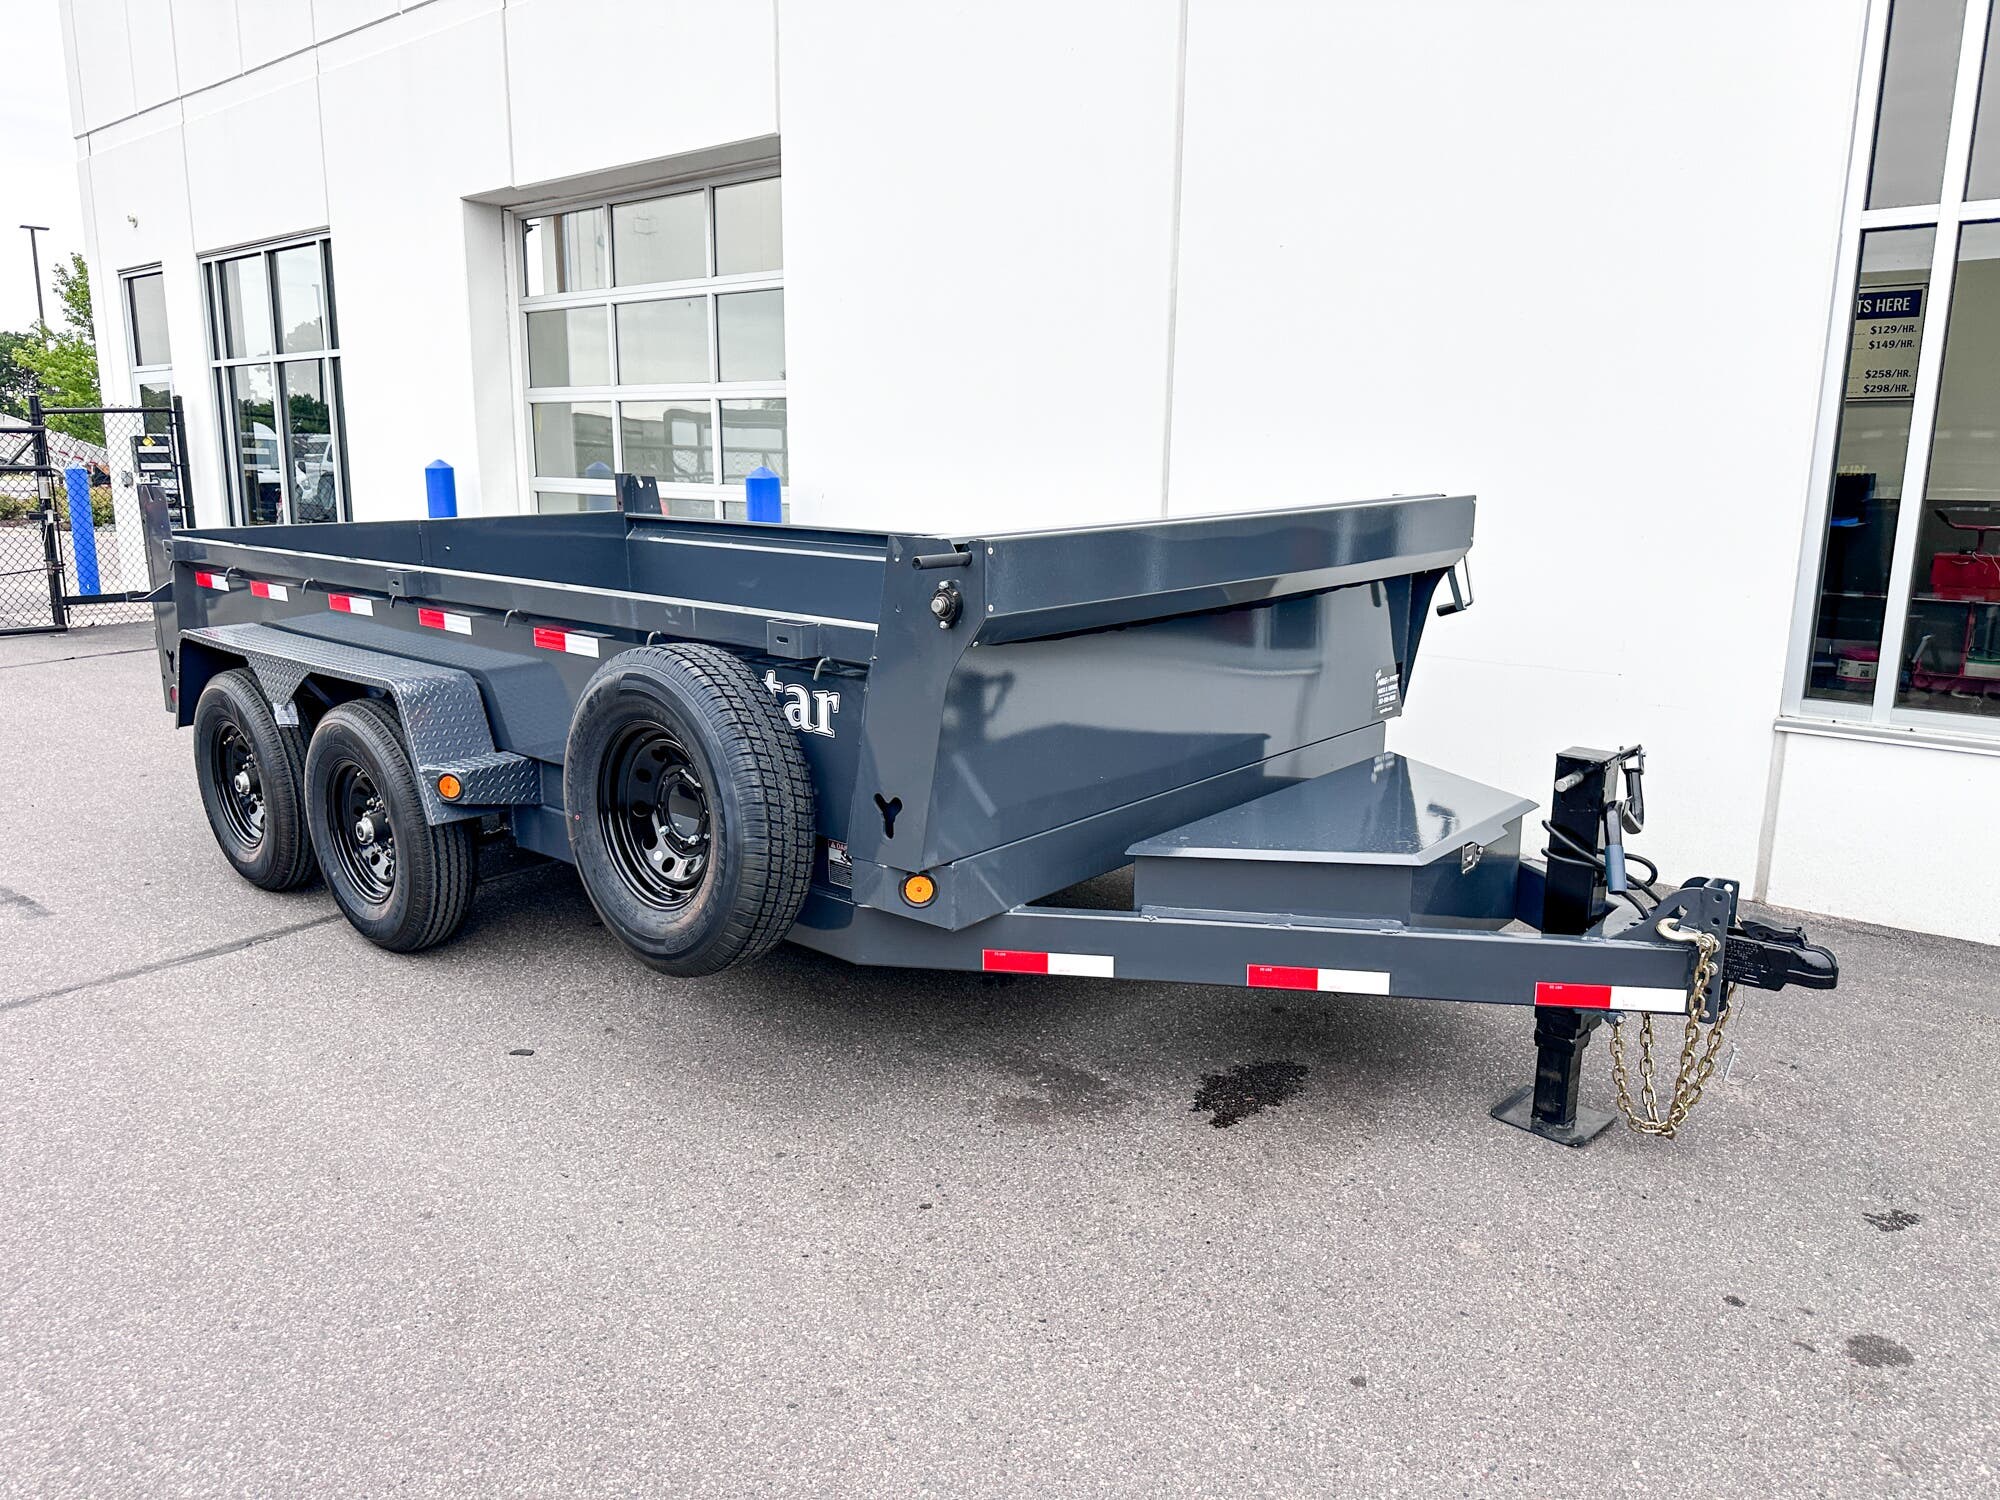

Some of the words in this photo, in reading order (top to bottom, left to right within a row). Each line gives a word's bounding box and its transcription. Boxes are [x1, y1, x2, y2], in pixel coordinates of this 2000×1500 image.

[1875, 297, 1911, 313] HERE
[1870, 324, 1917, 335] $129/HR.
[1868, 339, 1915, 350] $149/HR.
[1864, 369, 1912, 379] $258/HR.
[1863, 384, 1910, 394] $298/HR.
